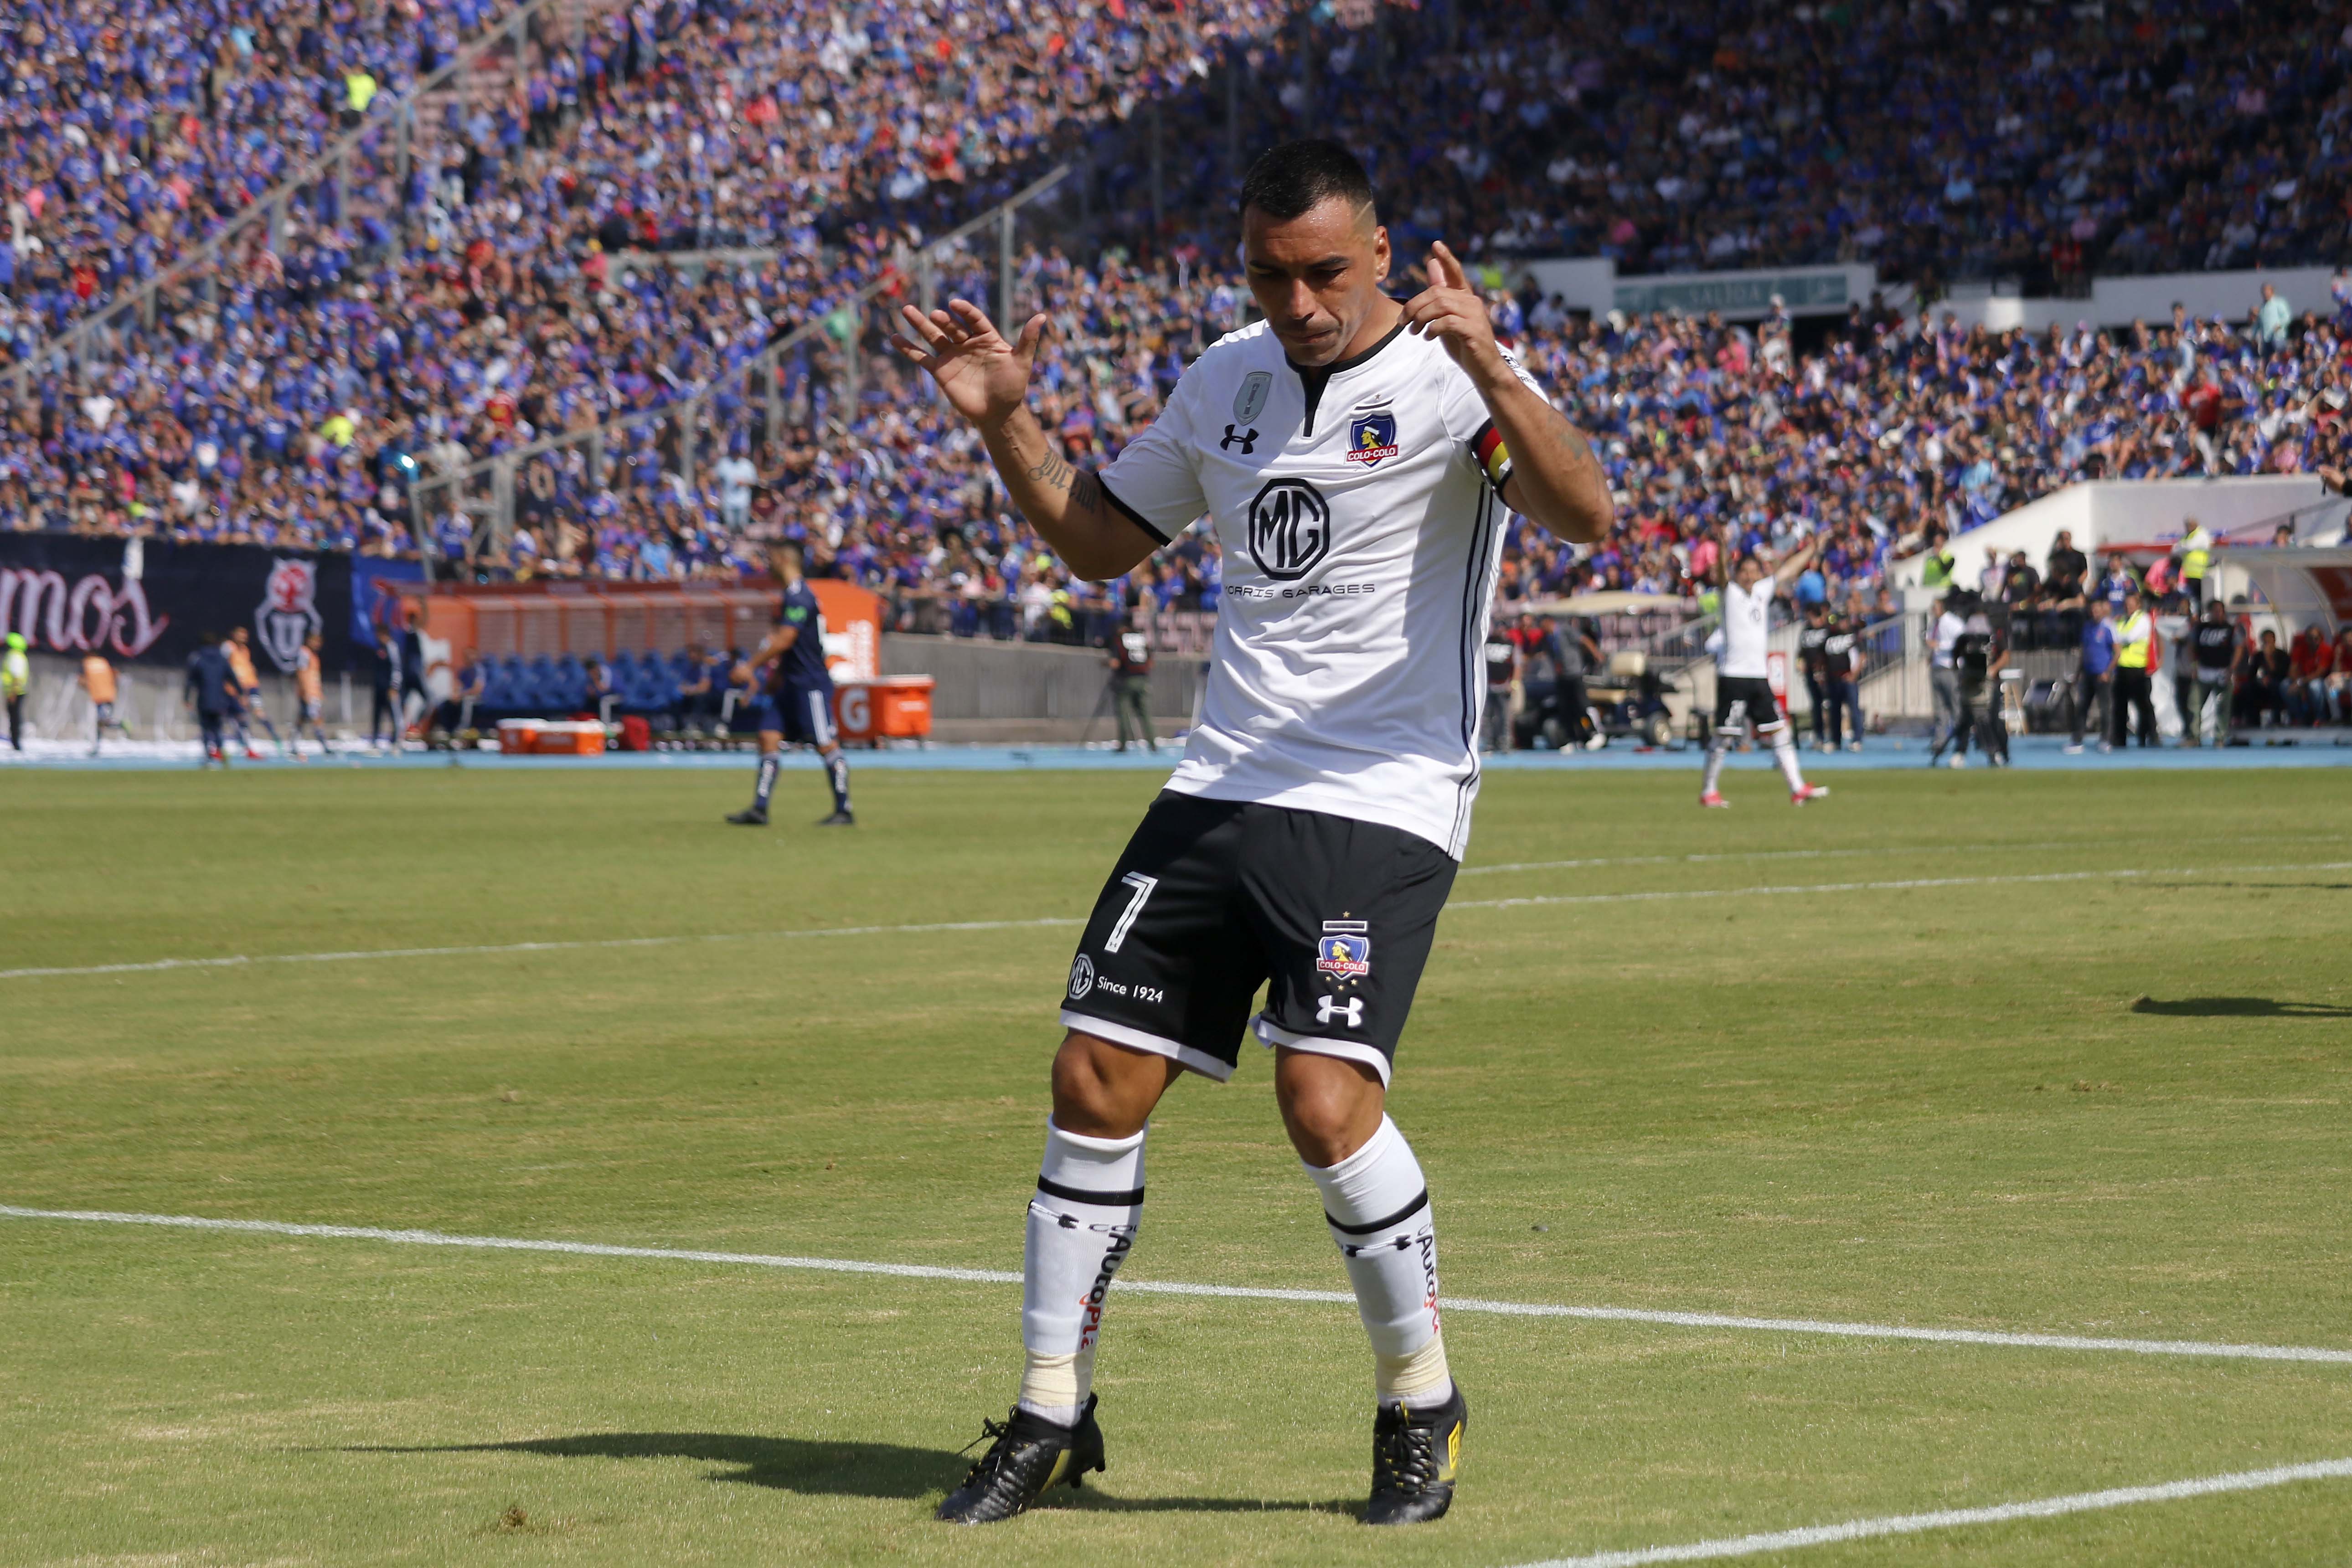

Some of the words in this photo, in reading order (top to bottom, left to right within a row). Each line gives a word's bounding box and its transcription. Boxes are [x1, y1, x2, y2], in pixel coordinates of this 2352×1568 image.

[1257, 490, 1320, 569] MG
[1282, 583, 1375, 598] GARAGES
[1104, 871, 1159, 954] 7
[1071, 957, 1091, 995] MG
[1097, 976, 1127, 995] Since
[1133, 985, 1163, 1003] 1924
